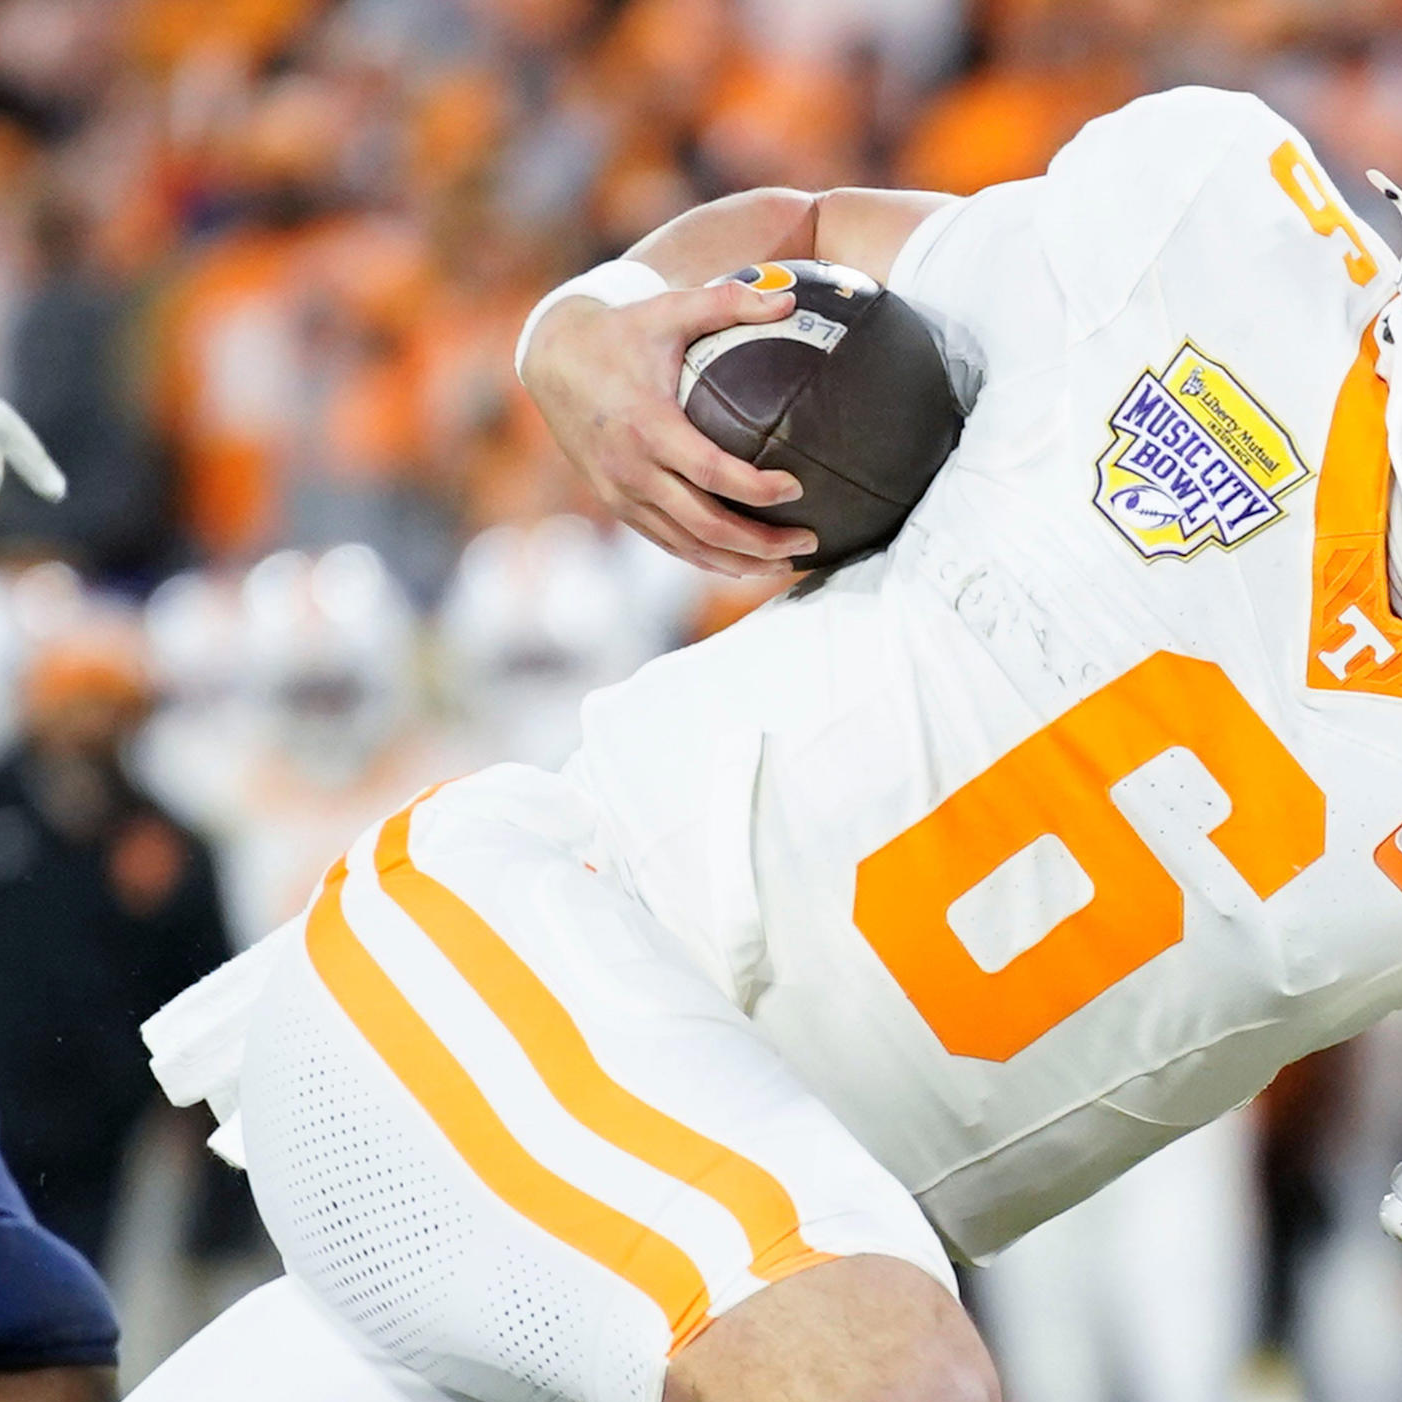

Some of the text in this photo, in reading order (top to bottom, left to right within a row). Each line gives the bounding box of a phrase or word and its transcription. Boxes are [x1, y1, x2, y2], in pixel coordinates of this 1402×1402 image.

[1123, 383, 1270, 530] MUSIC CITY
[1201, 392, 1281, 473] Liberty Mutual
[1206, 419, 1252, 467] INSURANCE
[1128, 438, 1211, 524] BOWL
[1317, 604, 1397, 682] T
[852, 649, 1327, 1063] 6
